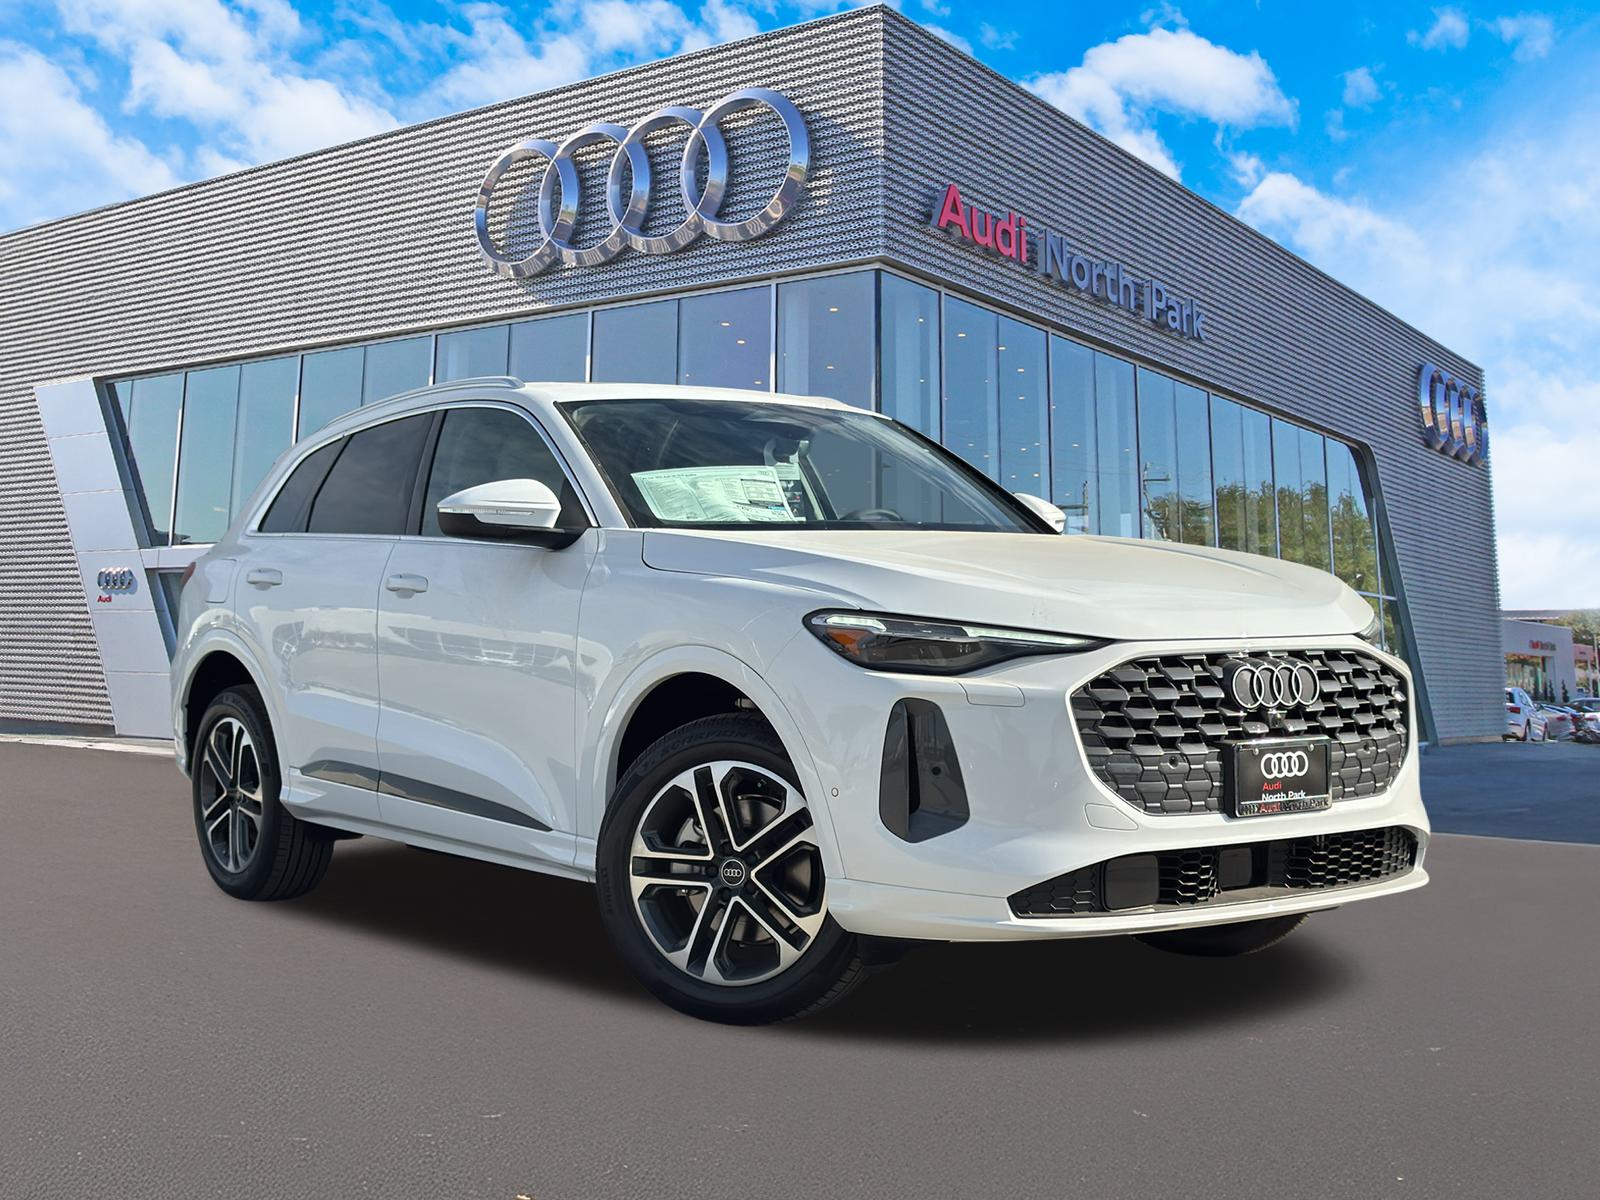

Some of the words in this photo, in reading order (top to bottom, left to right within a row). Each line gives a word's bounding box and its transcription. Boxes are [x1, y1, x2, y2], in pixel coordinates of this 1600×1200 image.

[932, 184, 1028, 263] Audi
[1039, 229, 1136, 310] North
[1144, 279, 1206, 341] Park
[1263, 782, 1282, 791] Audi
[1261, 792, 1286, 802] North
[1288, 790, 1306, 800] Park
[1260, 803, 1281, 813] Audi
[1309, 799, 1330, 808] Park
